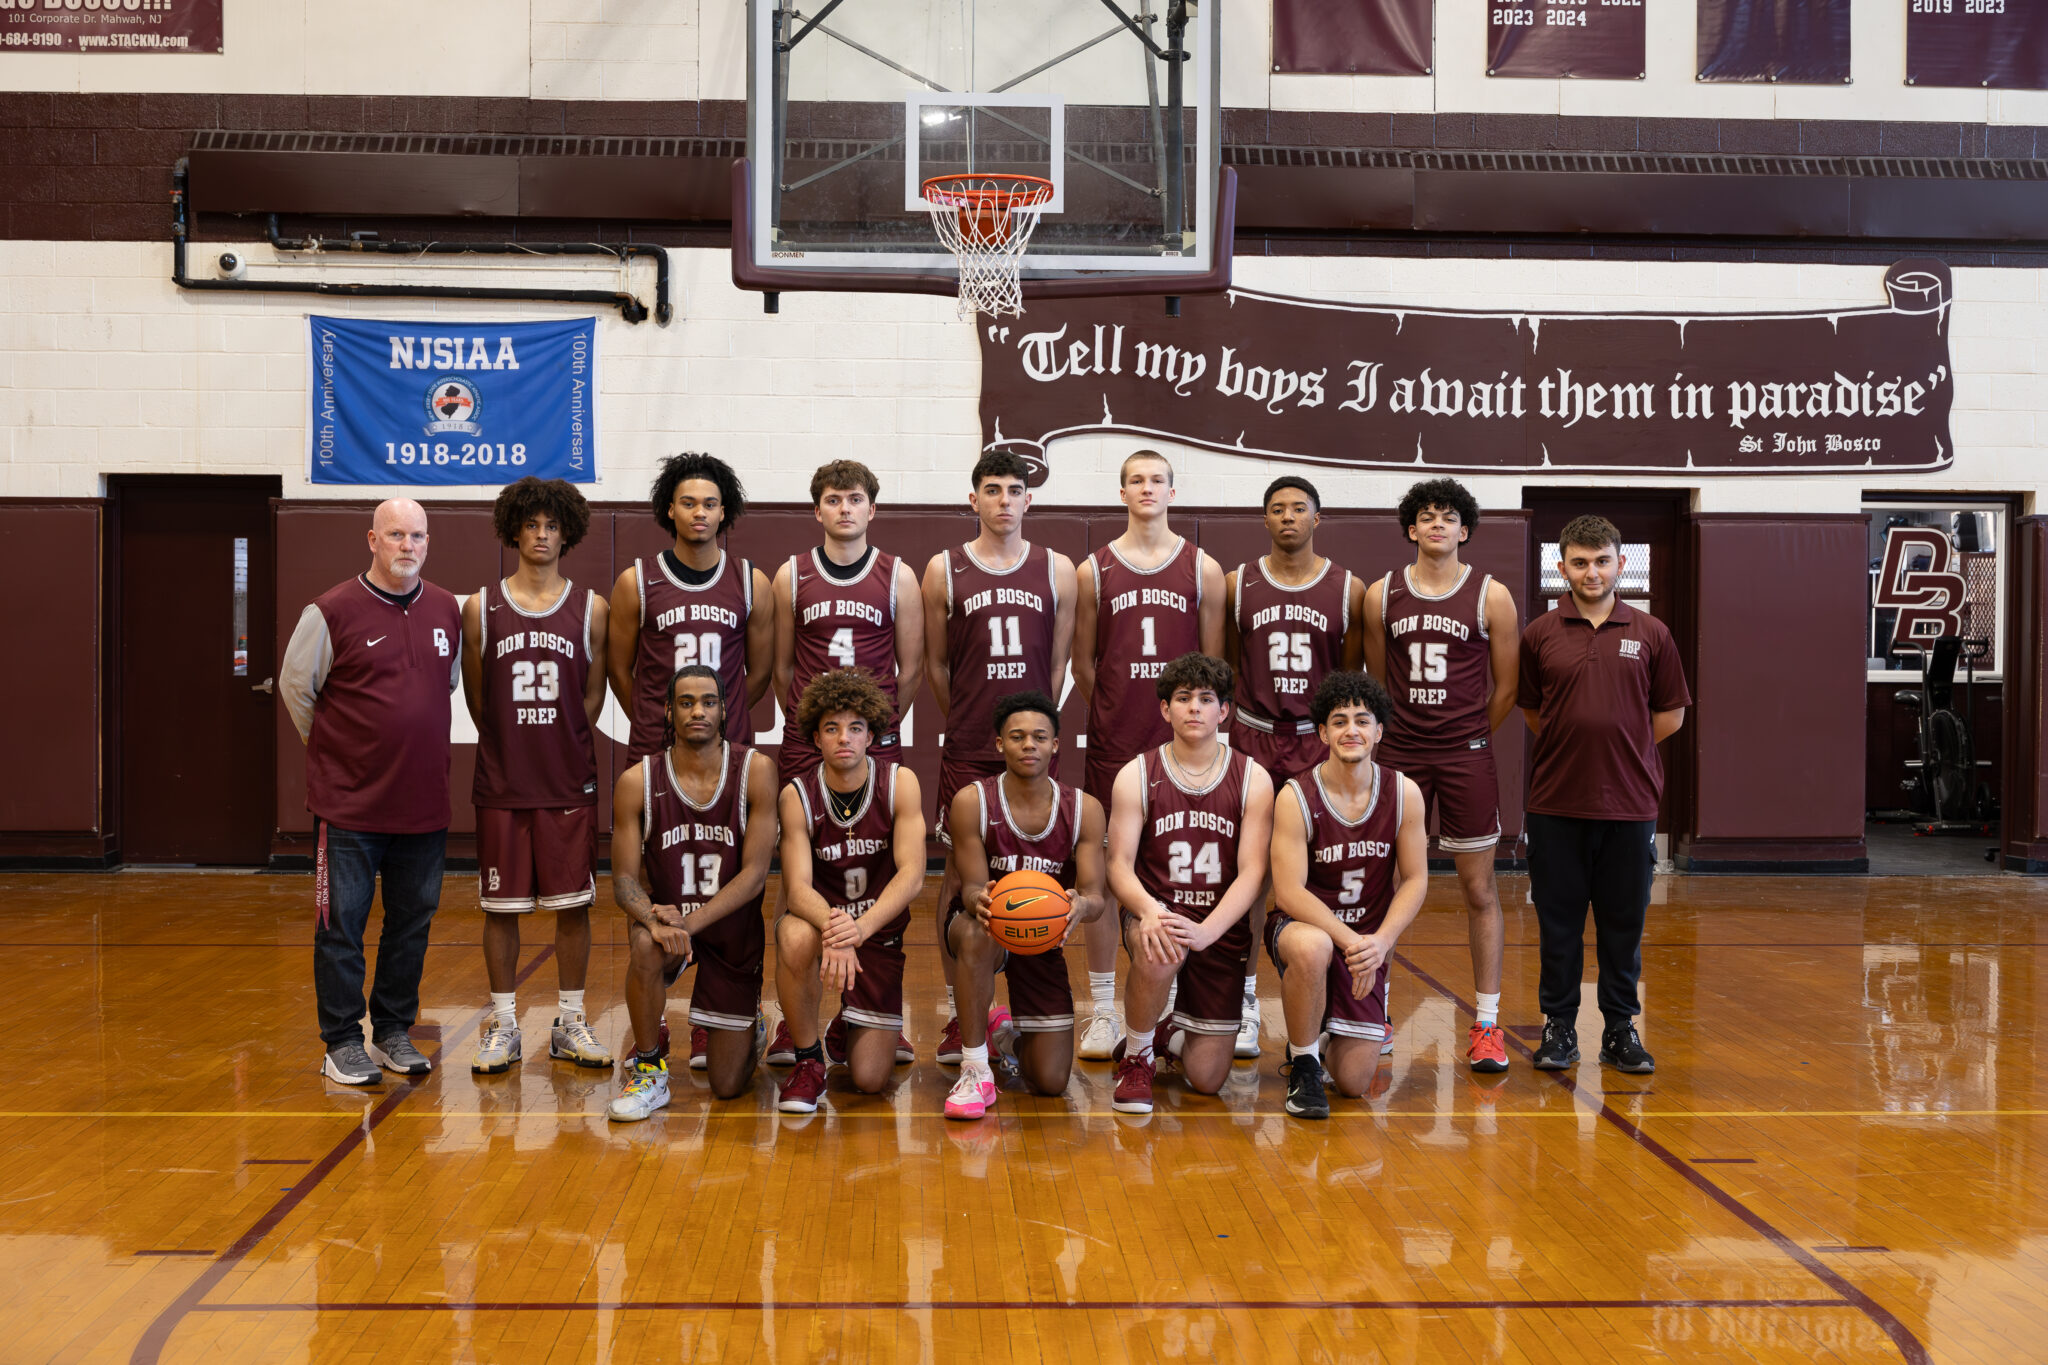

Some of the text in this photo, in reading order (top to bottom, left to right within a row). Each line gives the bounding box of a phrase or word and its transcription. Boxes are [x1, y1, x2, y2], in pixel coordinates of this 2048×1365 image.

[8, 13, 162, 25] 101 Corporate Dr. Mahwah, NJ
[1493, 9, 1587, 26] 2023 2024
[1912, 0, 2005, 13] 2019 2023
[79, 33, 189, 47] www.STACKNJ.com
[389, 336, 520, 370] NJSIAA
[319, 329, 337, 467] 100th Anniversary
[1135, 342, 1206, 396] my
[1216, 346, 1327, 414] boys
[1338, 360, 1384, 413] I
[1389, 367, 1527, 418] await
[1538, 368, 1656, 428] them
[1668, 373, 1715, 420] in
[569, 332, 587, 471] 100th Anniversary
[385, 442, 527, 466] 1918-2018
[1739, 433, 1881, 456] St John Bosco
[803, 600, 883, 627] DON BOSCO
[964, 588, 1043, 616] DON BOSCO
[1111, 588, 1187, 615] DON BOSCO
[656, 604, 738, 632] DON BOSCO
[1252, 604, 1328, 633] DON BOSCO
[1391, 614, 1470, 642] DON BOSCO
[433, 628, 450, 656] DB
[497, 631, 574, 659] DON BOSCO
[828, 628, 856, 666] 4
[988, 616, 1023, 657] 11
[1141, 616, 1157, 656] 1
[1619, 639, 1641, 655] DBP
[674, 632, 721, 672] 20
[1268, 632, 1312, 672] 25
[1408, 642, 1449, 682] 15
[512, 661, 560, 701] 23
[987, 662, 1027, 680] PREP
[1274, 677, 1308, 695] PREP
[1409, 688, 1447, 705] PREP
[517, 708, 557, 725] PREP
[662, 824, 690, 850] DON
[1156, 810, 1234, 838] DON BOSCO
[814, 839, 888, 861] DON BOSCO
[989, 854, 1064, 874] DON BOSCO
[1168, 841, 1222, 884] 24
[681, 852, 722, 896] 13
[844, 866, 867, 900] 0
[1338, 867, 1366, 905] 5
[1173, 890, 1215, 906] PREP
[1331, 908, 1366, 923] REP
[1005, 925, 1049, 938] ELITE
